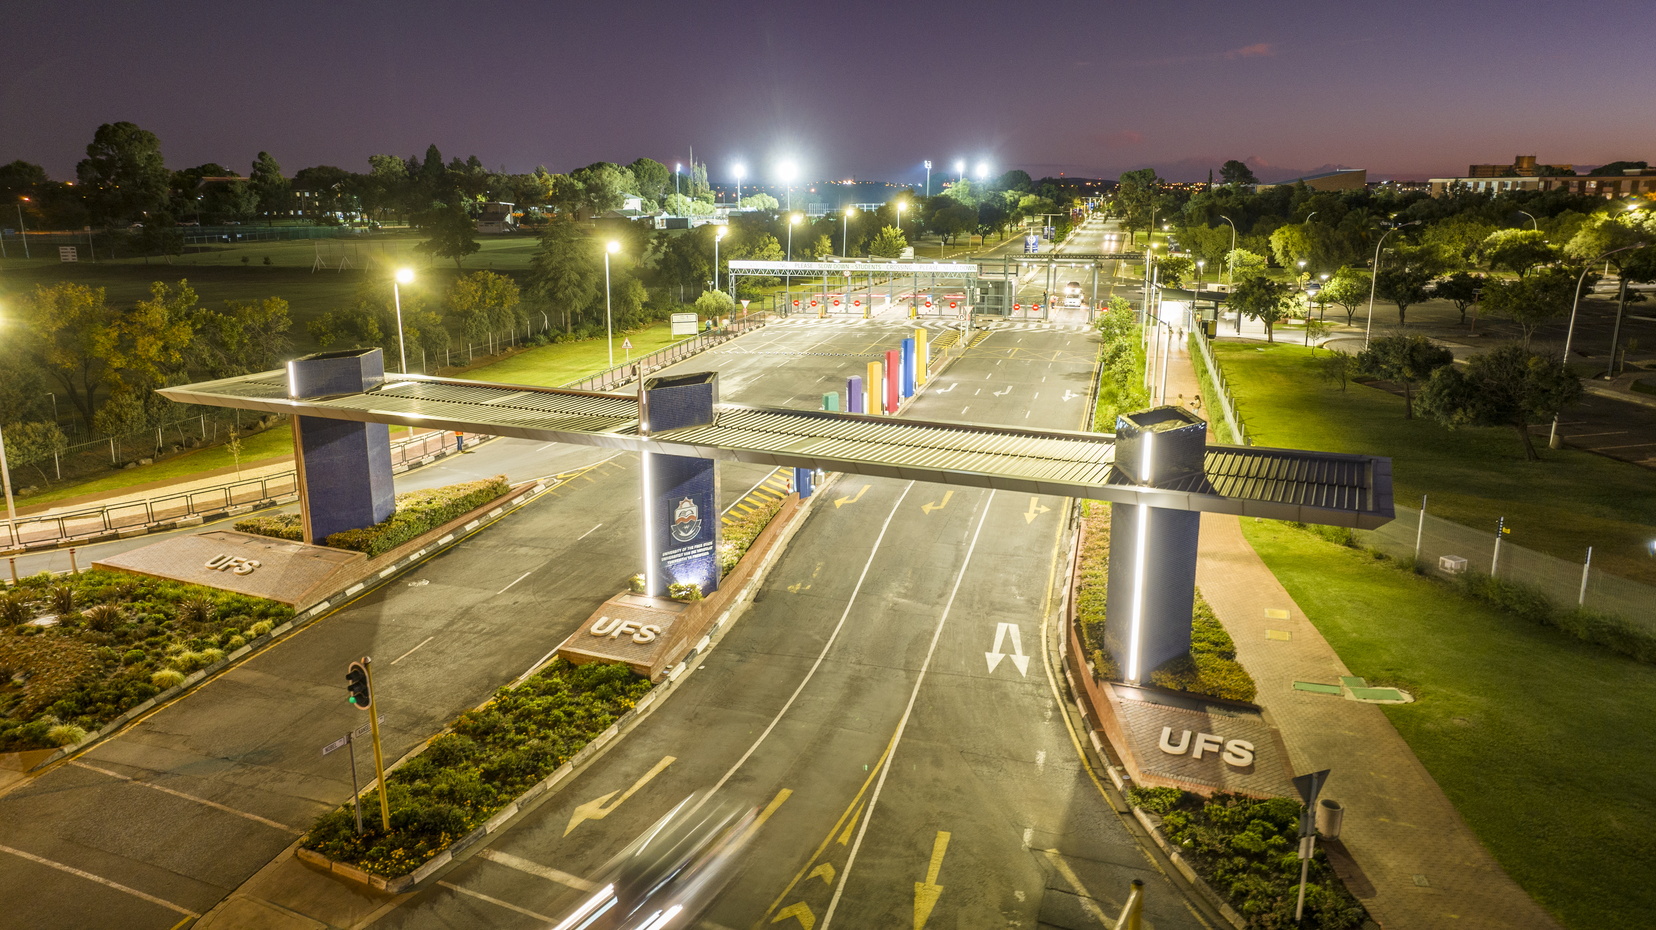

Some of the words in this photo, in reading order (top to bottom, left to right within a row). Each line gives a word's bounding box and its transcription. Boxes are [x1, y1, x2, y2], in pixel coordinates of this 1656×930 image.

[205, 554, 261, 576] UFS
[590, 616, 661, 644] UFS
[1159, 726, 1255, 767] UFS
